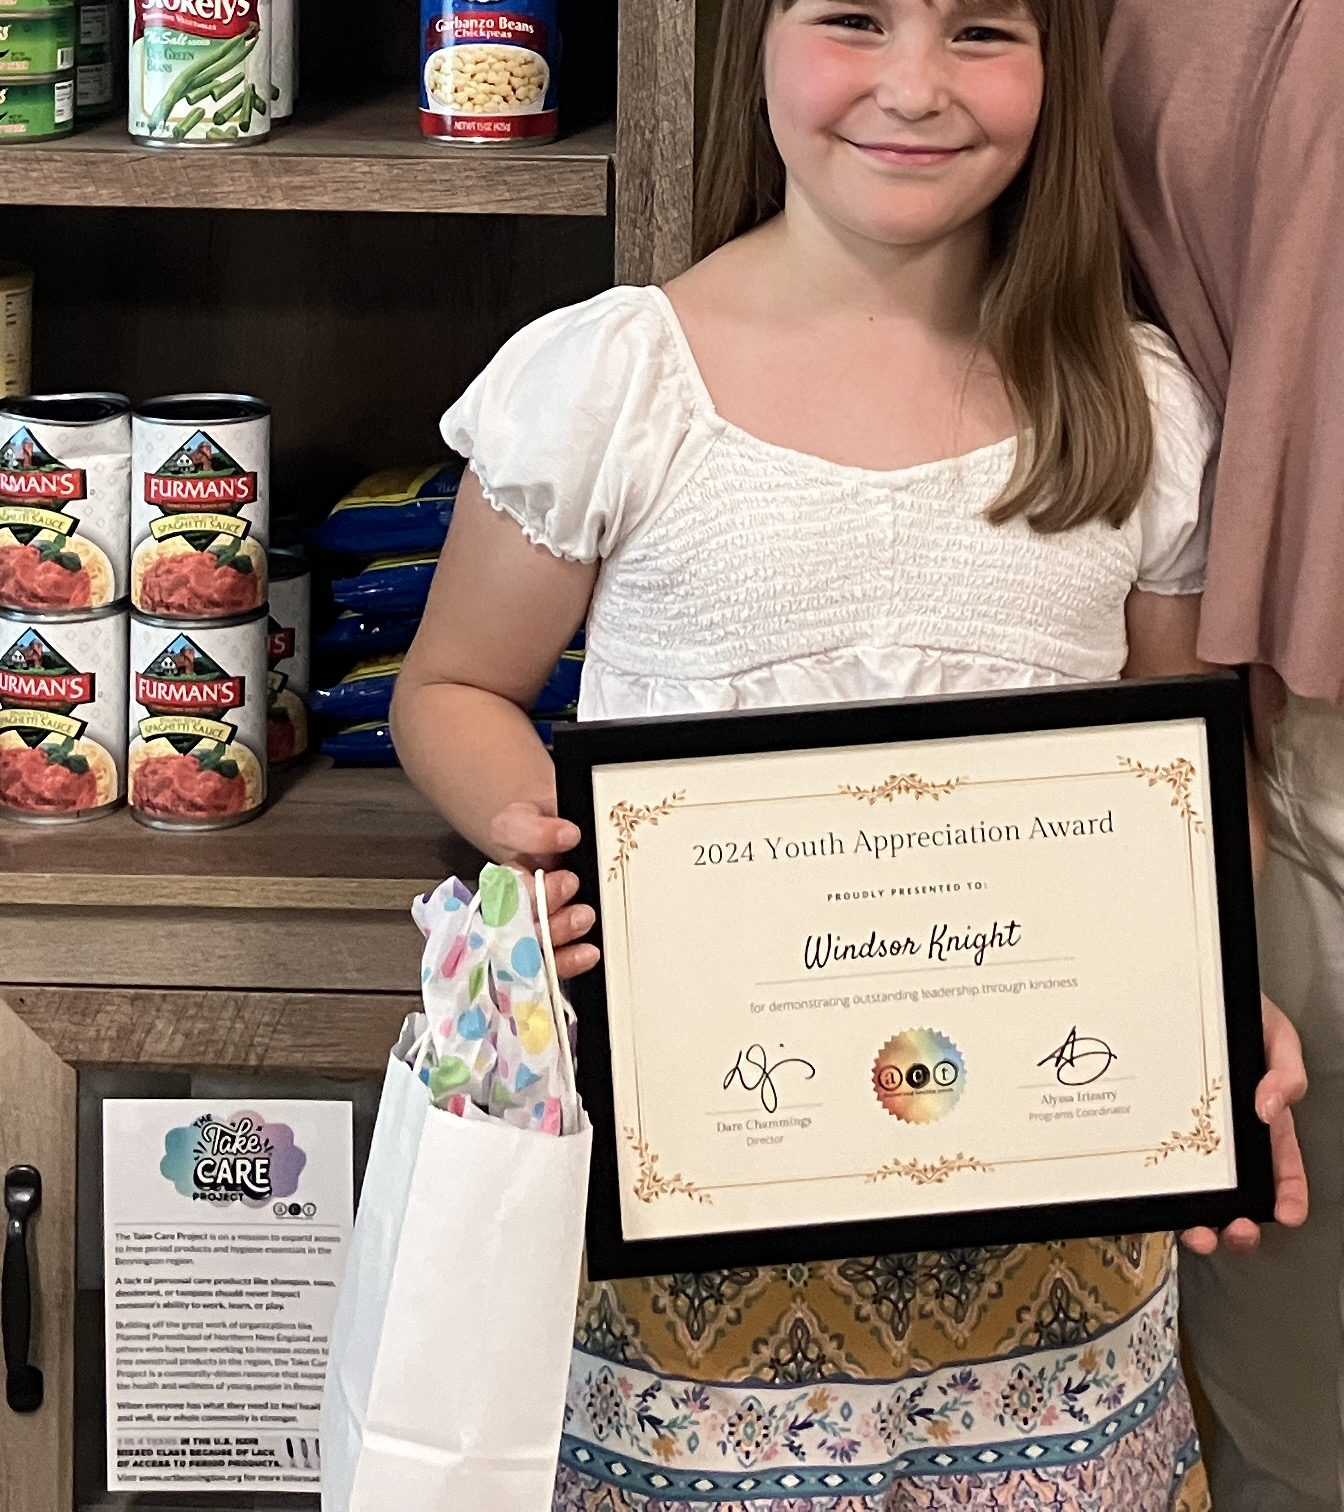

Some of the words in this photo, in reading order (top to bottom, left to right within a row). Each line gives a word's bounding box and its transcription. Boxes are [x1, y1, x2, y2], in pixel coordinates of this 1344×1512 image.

[435, 17, 494, 33] Garbanzo
[499, 17, 534, 34] Beans
[454, 29, 512, 39] Chickpeas
[150, 477, 249, 499] FURMAN'S
[138, 682, 234, 703] FURMAN'S
[693, 841, 754, 866] 2024
[763, 832, 844, 860] Youth
[854, 820, 1020, 859] Appreciation
[1029, 810, 1114, 840] Award
[827, 889, 885, 902] PROUDLY
[891, 883, 961, 897] PRESENTED
[804, 930, 922, 970] Windsor
[928, 919, 1022, 966] Knight
[750, 1002, 765, 1014] for
[769, 995, 851, 1013] demonstrating
[853, 989, 919, 1005] outstanding
[921, 984, 980, 999] leadership
[982, 980, 1026, 996] through
[1029, 977, 1079, 990] kindness
[193, 1113, 213, 1128] THE
[1076, 1105, 1131, 1119] Coordinator
[202, 1117, 262, 1156] Take
[717, 1121, 743, 1133] Dare
[747, 1135, 784, 1146] Director
[196, 1159, 272, 1194] CARE
[193, 1192, 244, 1202] PROJECT
